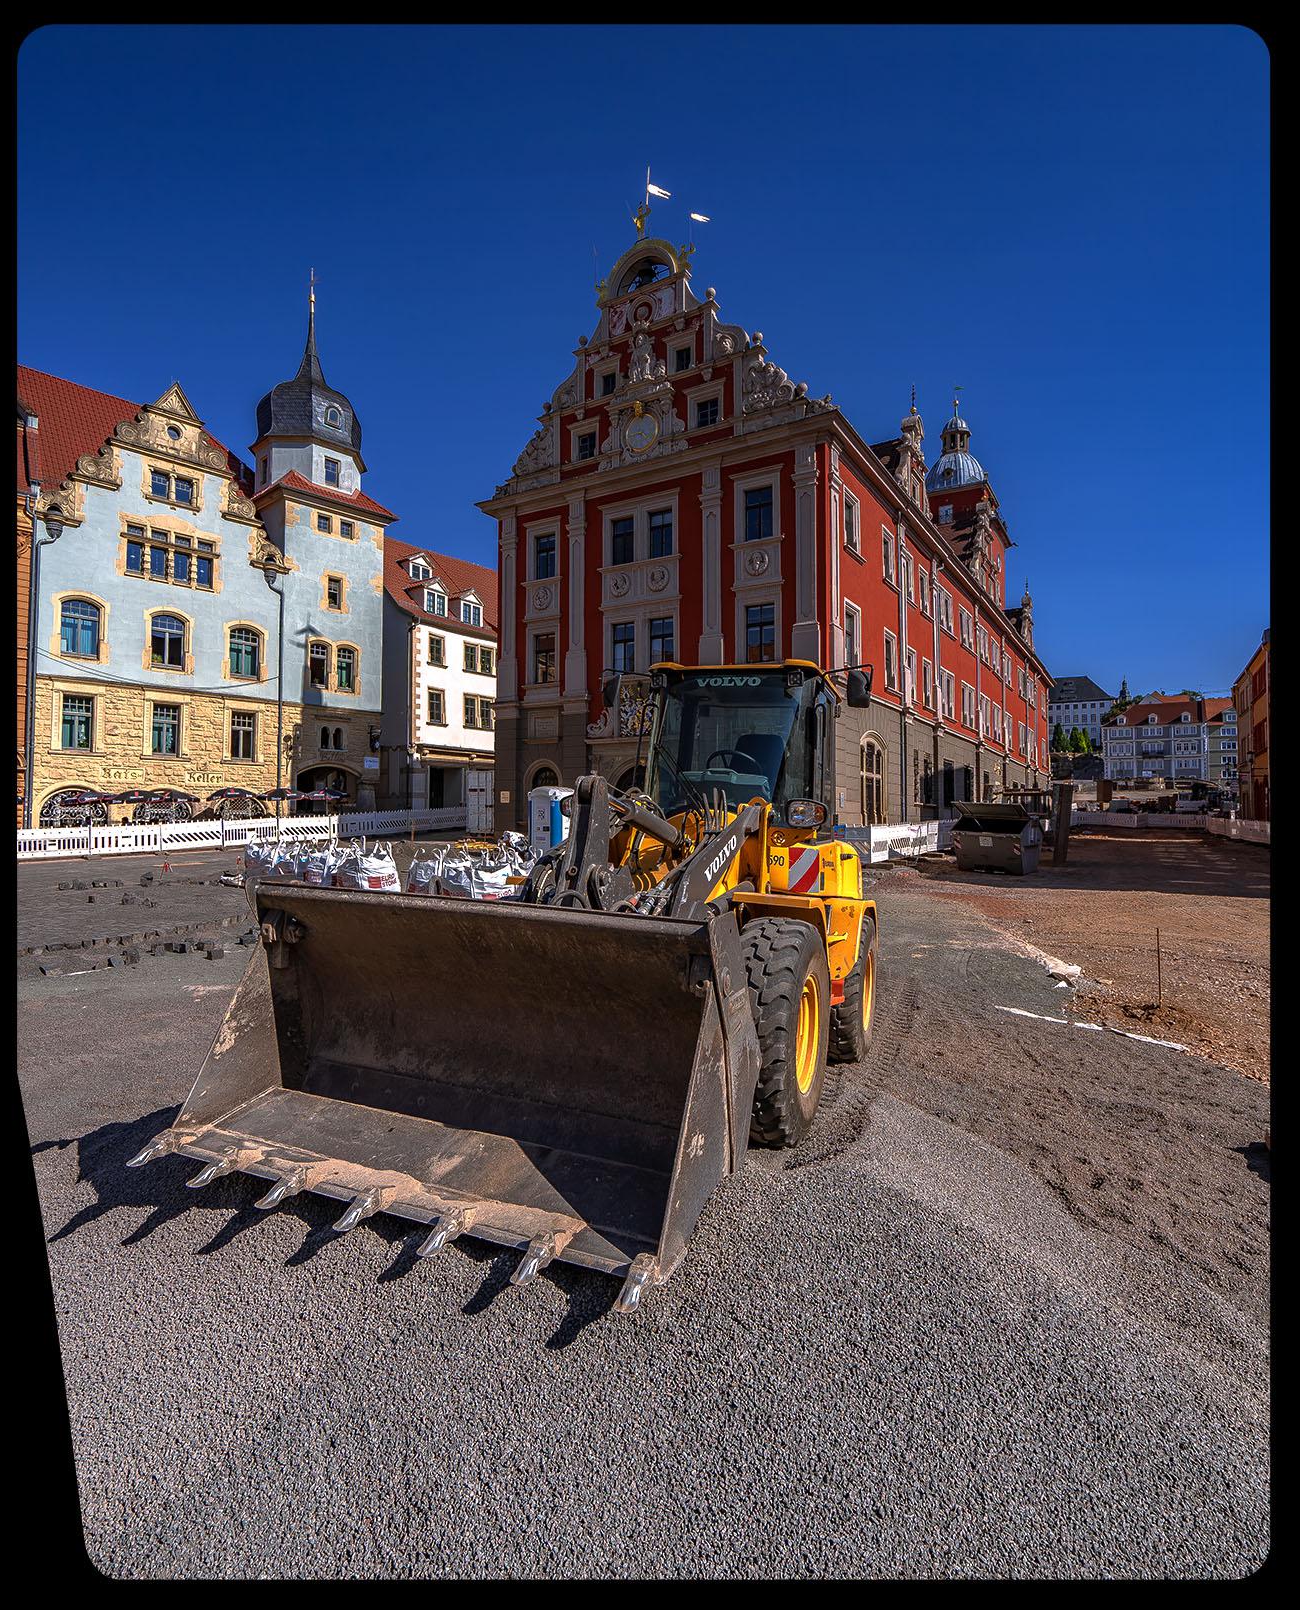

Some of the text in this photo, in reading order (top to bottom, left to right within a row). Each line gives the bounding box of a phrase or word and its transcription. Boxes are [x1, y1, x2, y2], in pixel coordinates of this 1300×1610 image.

[695, 677, 762, 687] VOLVO
[187, 771, 222, 783] Keller
[704, 834, 737, 882] VOLVO
